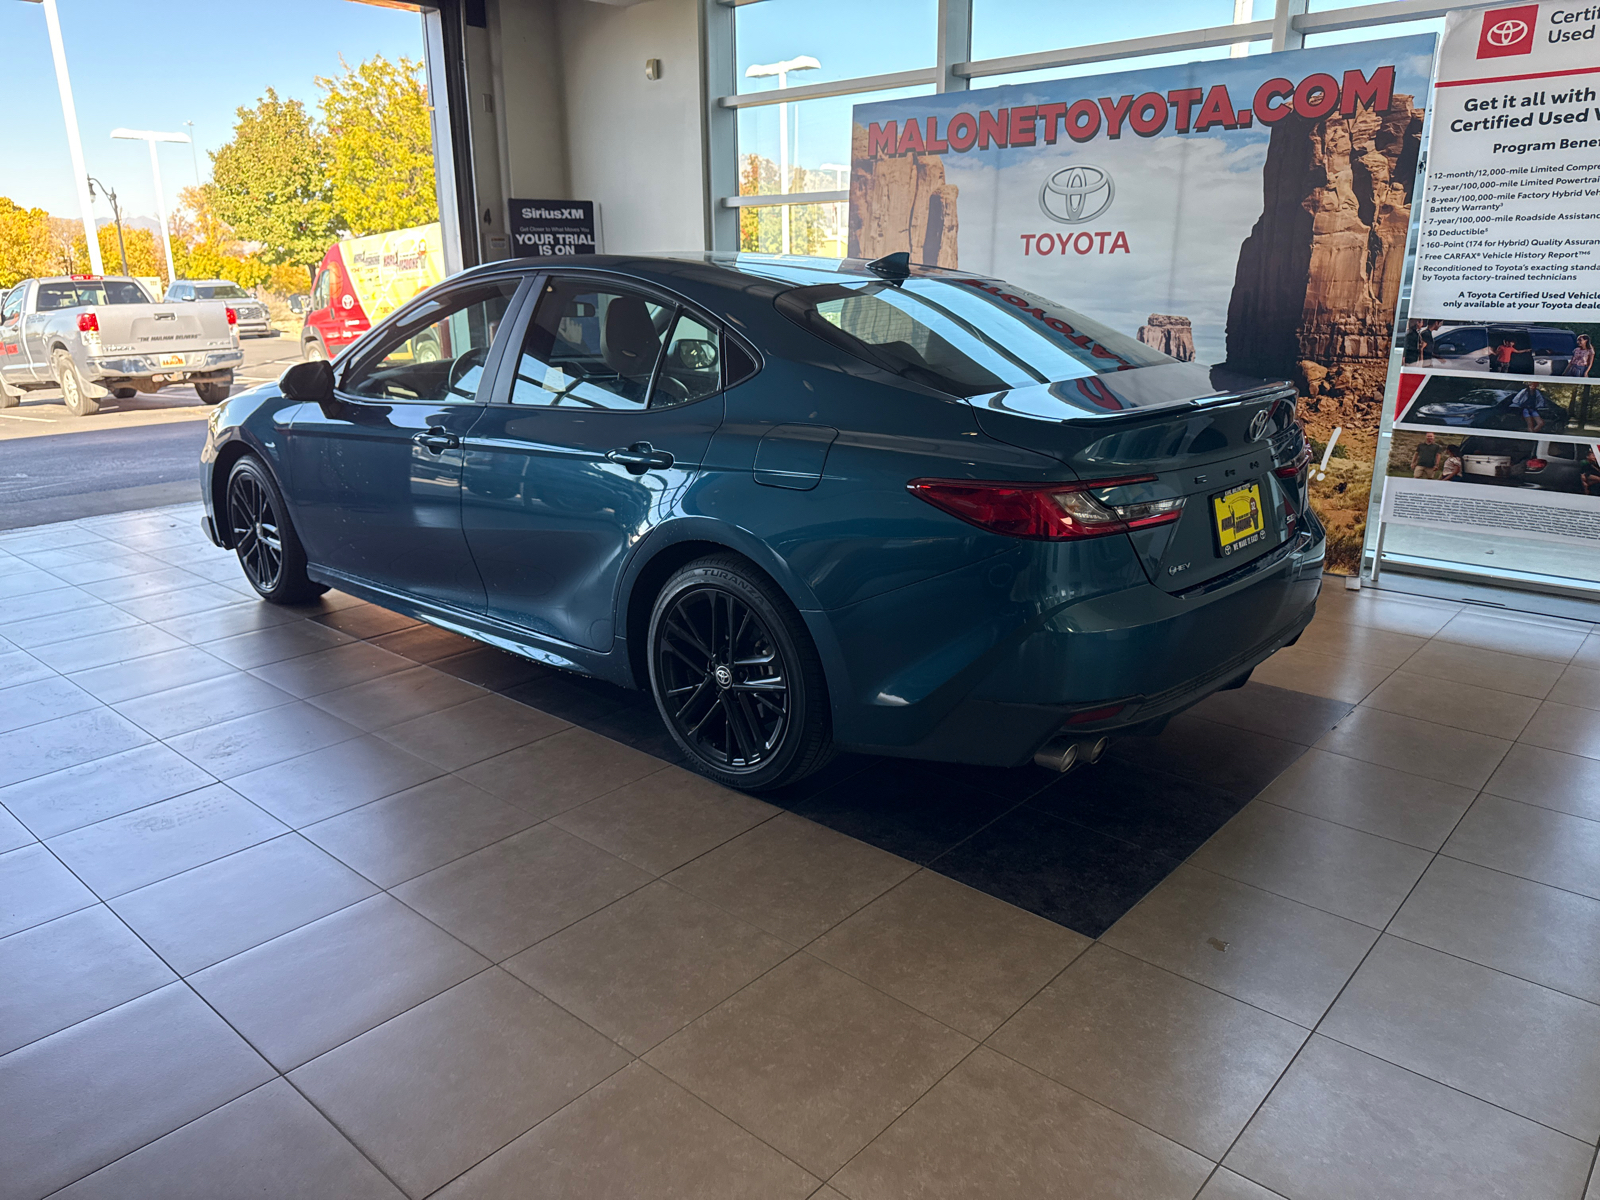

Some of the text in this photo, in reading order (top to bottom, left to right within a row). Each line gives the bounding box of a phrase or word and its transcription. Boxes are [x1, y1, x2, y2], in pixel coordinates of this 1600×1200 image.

[1548, 24, 1596, 44] Used
[1464, 87, 1596, 112] Get it all with
[868, 65, 1396, 159] MALONETOYOTA.COM
[1450, 113, 1534, 132] Certified
[1538, 108, 1589, 126] Used
[1492, 140, 1556, 154] Program
[1434, 168, 1529, 180] 12-month/12,000-mile
[1530, 164, 1564, 174] Limited
[1432, 180, 1518, 192] 7-year/100,000-mile
[1520, 178, 1554, 188] Limited
[1431, 192, 1516, 204] 8-year/100,000-mile
[1517, 191, 1550, 200] Factory
[1552, 190, 1583, 199] Hybrid
[521, 208, 584, 220] SiriusXM
[1430, 206, 1460, 214] Battery
[1428, 214, 1514, 226] 7-year/100,000-mile
[1515, 213, 1556, 222] Roadside
[515, 234, 554, 245] YOUR
[556, 234, 595, 246] TRIAL
[1020, 230, 1130, 256] TOYOTA
[1426, 240, 1465, 249] 160-Point
[1465, 240, 1483, 248] (174
[1498, 238, 1529, 248] Hybrid)
[1531, 238, 1564, 247] Quality
[539, 245, 575, 256] IS ON
[1514, 252, 1547, 260] History
[1495, 264, 1529, 272] Toyota's
[1530, 264, 1569, 272] exacting
[1422, 274, 1432, 282] by
[1434, 274, 1460, 282] Toyota
[1462, 274, 1526, 282] factory-trained
[1466, 291, 1497, 300] Toyota
[1498, 291, 1540, 299] Certified
[1442, 300, 1463, 308] only
[1541, 302, 1574, 310] Toyota
